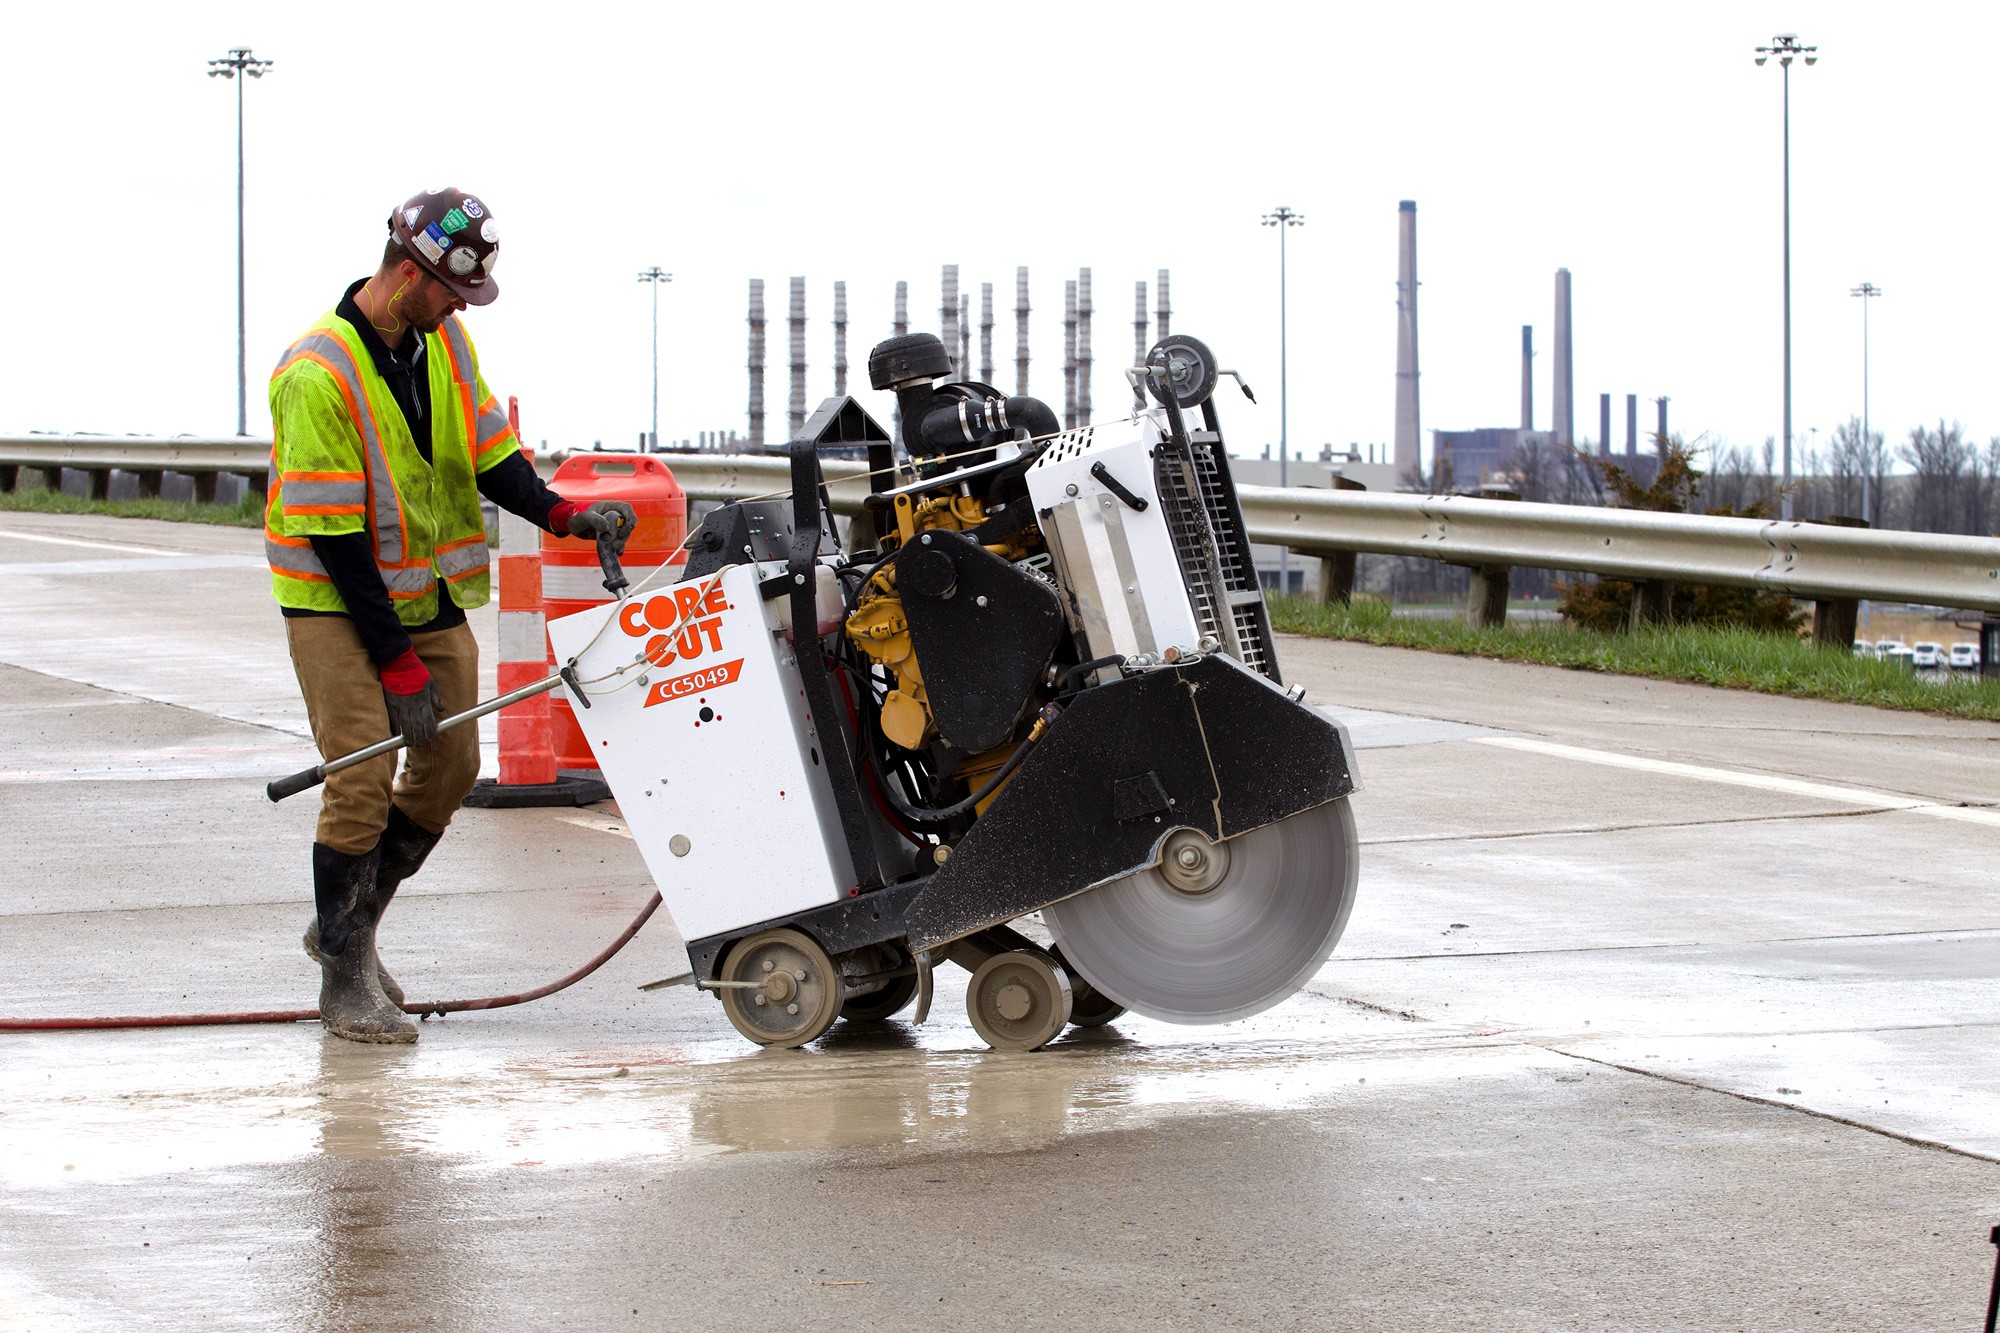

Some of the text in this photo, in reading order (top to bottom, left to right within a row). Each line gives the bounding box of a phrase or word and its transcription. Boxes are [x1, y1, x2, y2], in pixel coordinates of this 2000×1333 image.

[619, 578, 728, 637] CORE
[645, 616, 723, 667] CUT
[660, 667, 729, 698] CC5049
